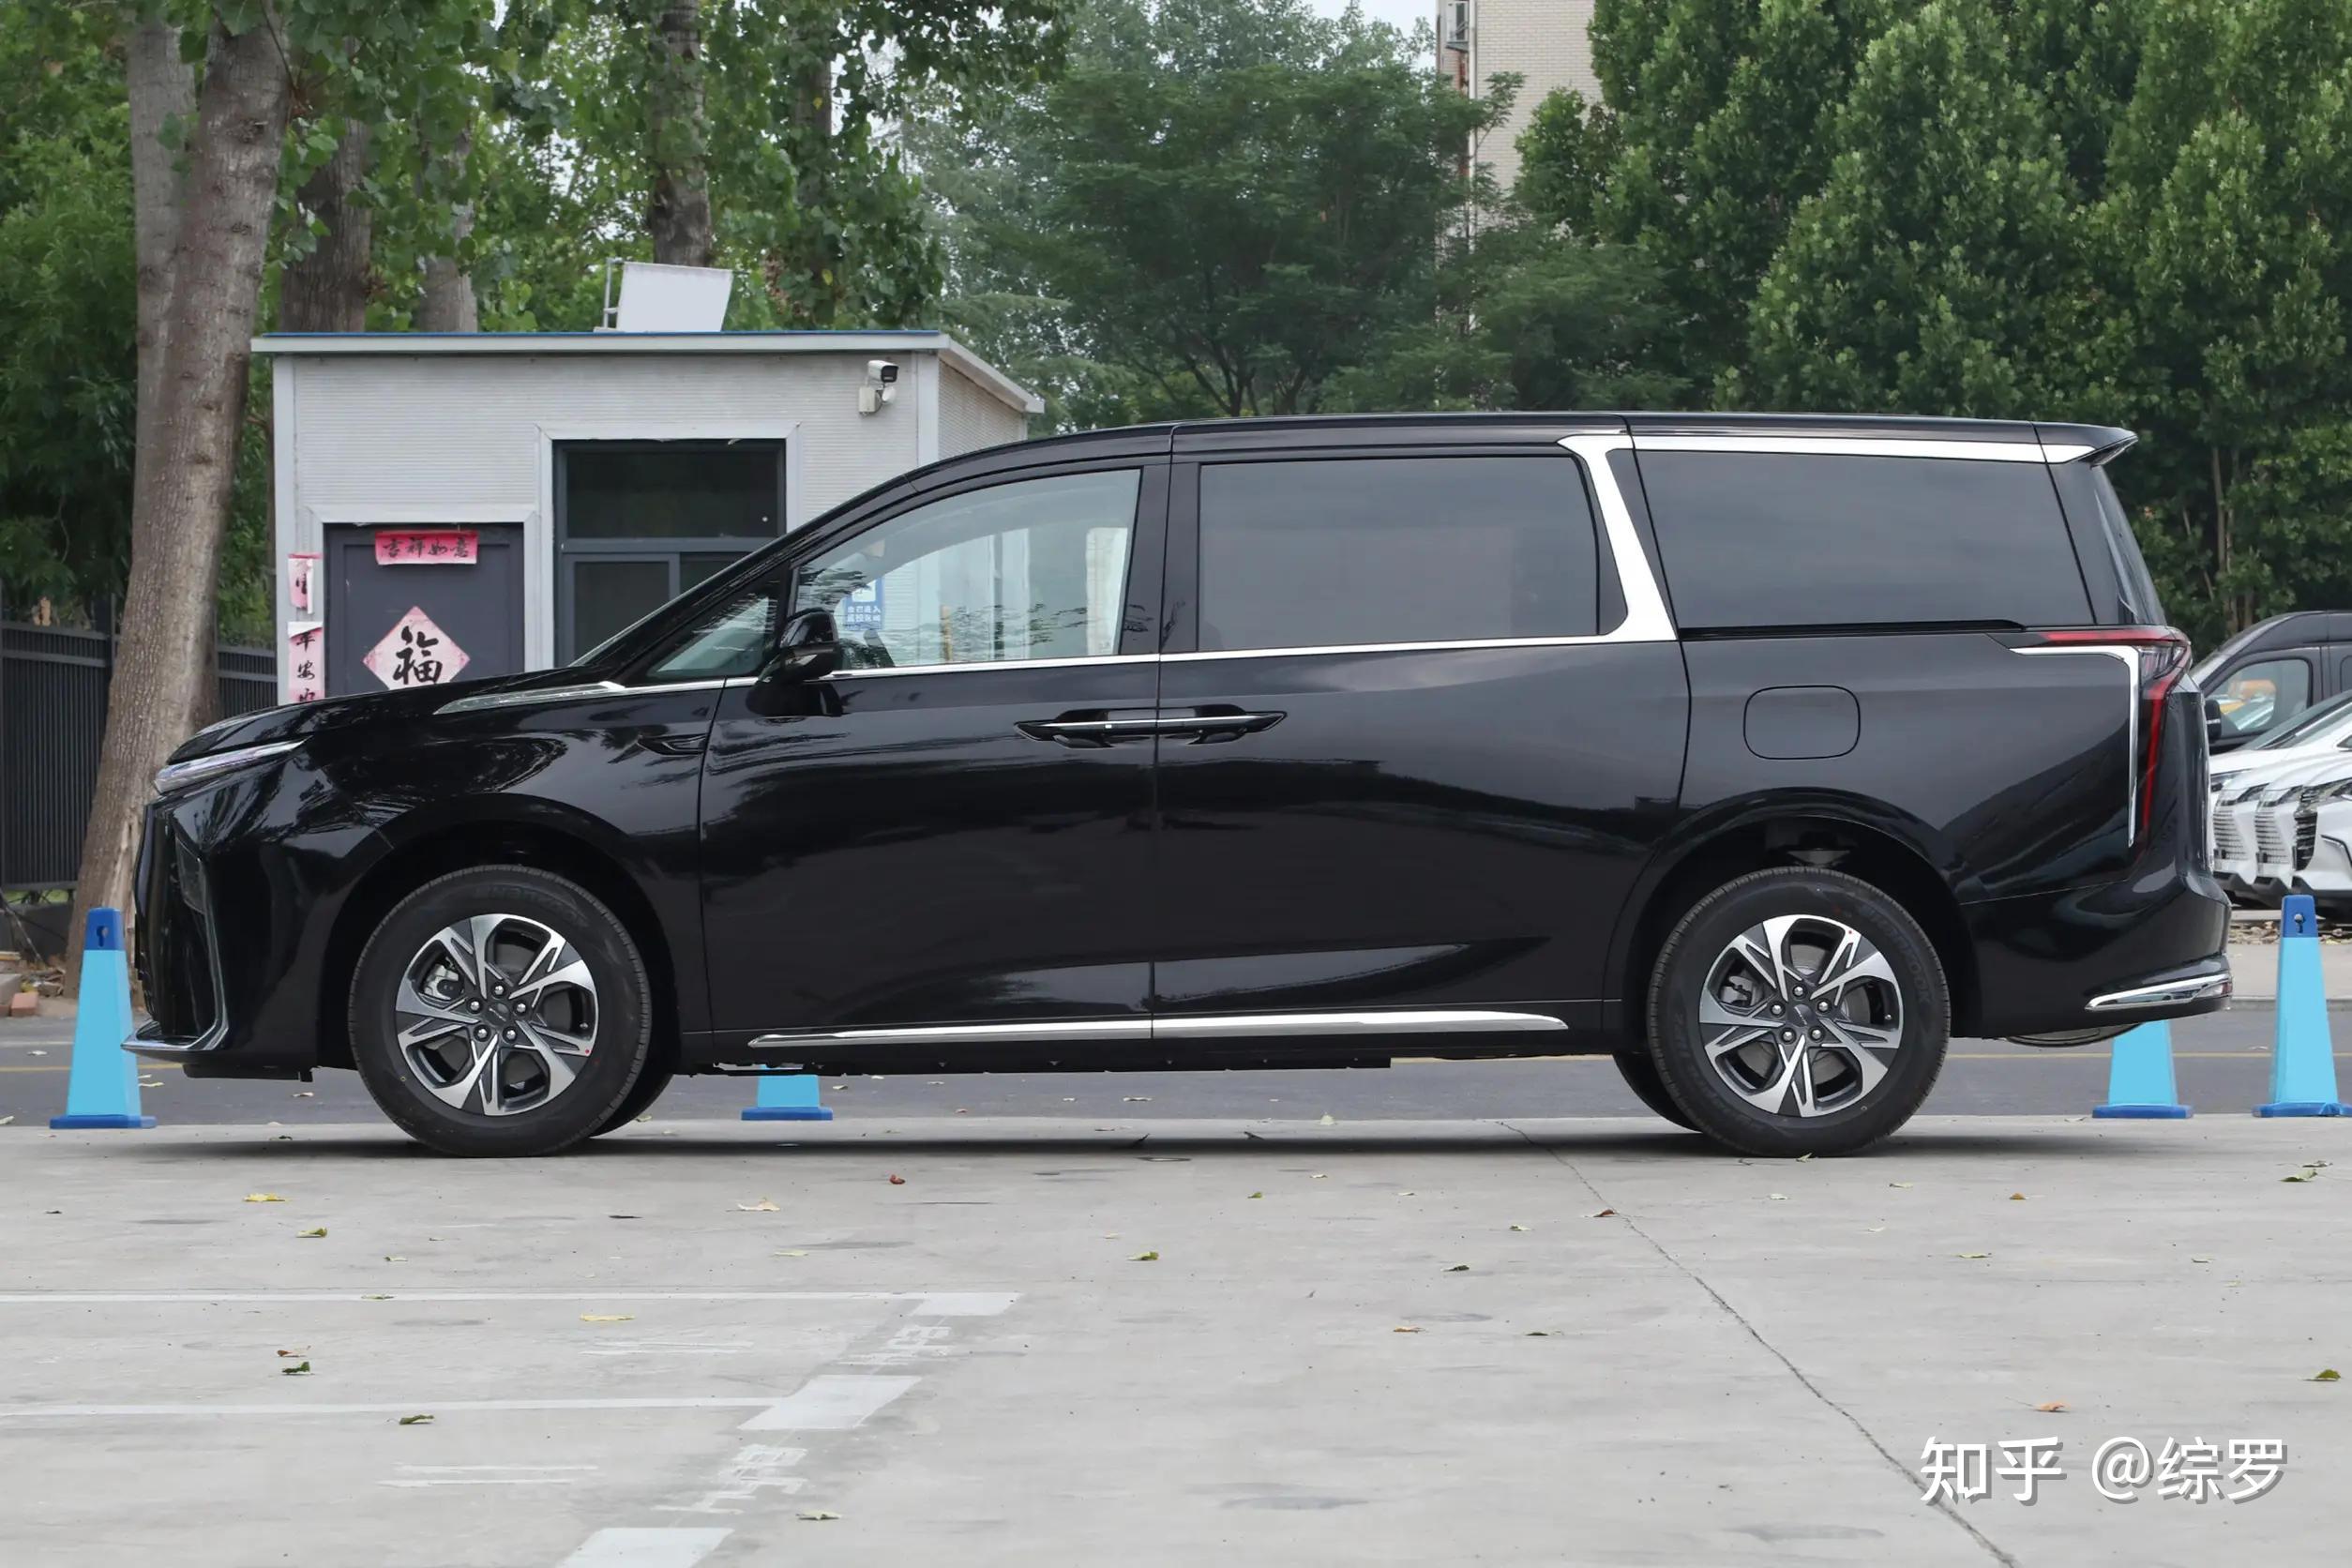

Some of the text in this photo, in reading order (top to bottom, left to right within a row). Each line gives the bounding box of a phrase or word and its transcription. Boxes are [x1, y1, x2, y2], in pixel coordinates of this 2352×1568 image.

[382, 535, 471, 558] 吉祥如意
[392, 626, 444, 685] 福
